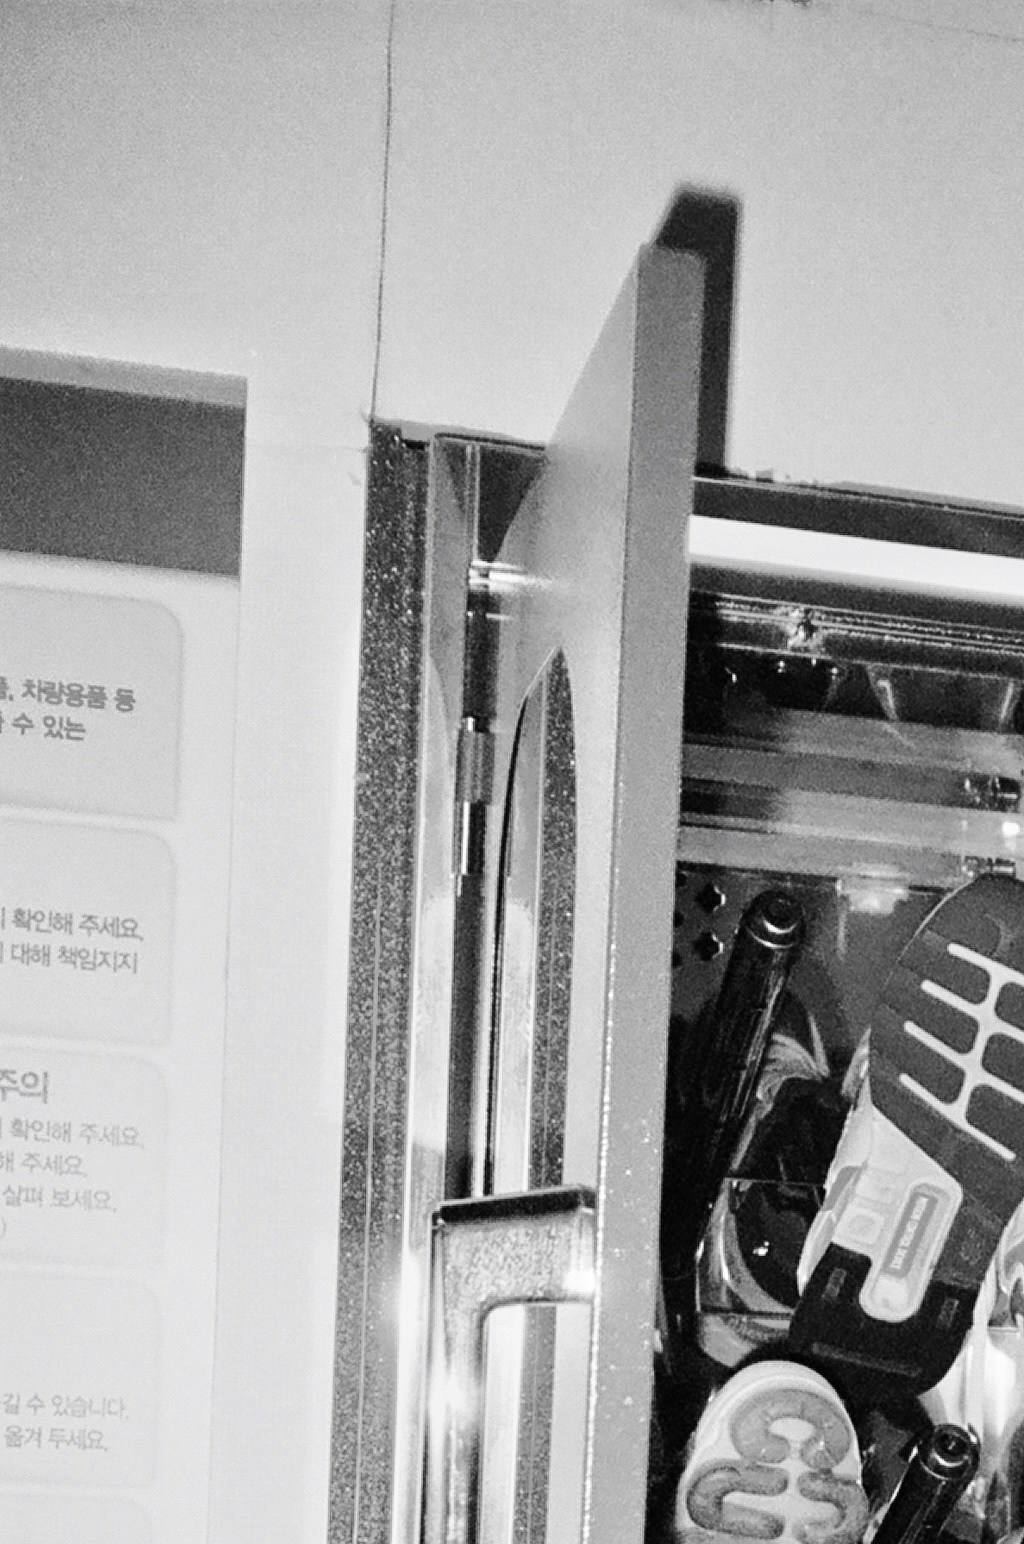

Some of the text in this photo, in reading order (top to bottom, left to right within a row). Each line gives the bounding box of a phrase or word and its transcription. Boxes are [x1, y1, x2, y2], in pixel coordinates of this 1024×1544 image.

[22, 679, 107, 710] 차량용품
[12, 713, 86, 741] 수 있는
[13, 908, 73, 935] 확인해
[11, 943, 138, 973] 대해 책임지지
[11, 1118, 71, 1143] 확인해
[2, 1184, 43, 1208] 살펴
[26, 1393, 44, 1416] 수
